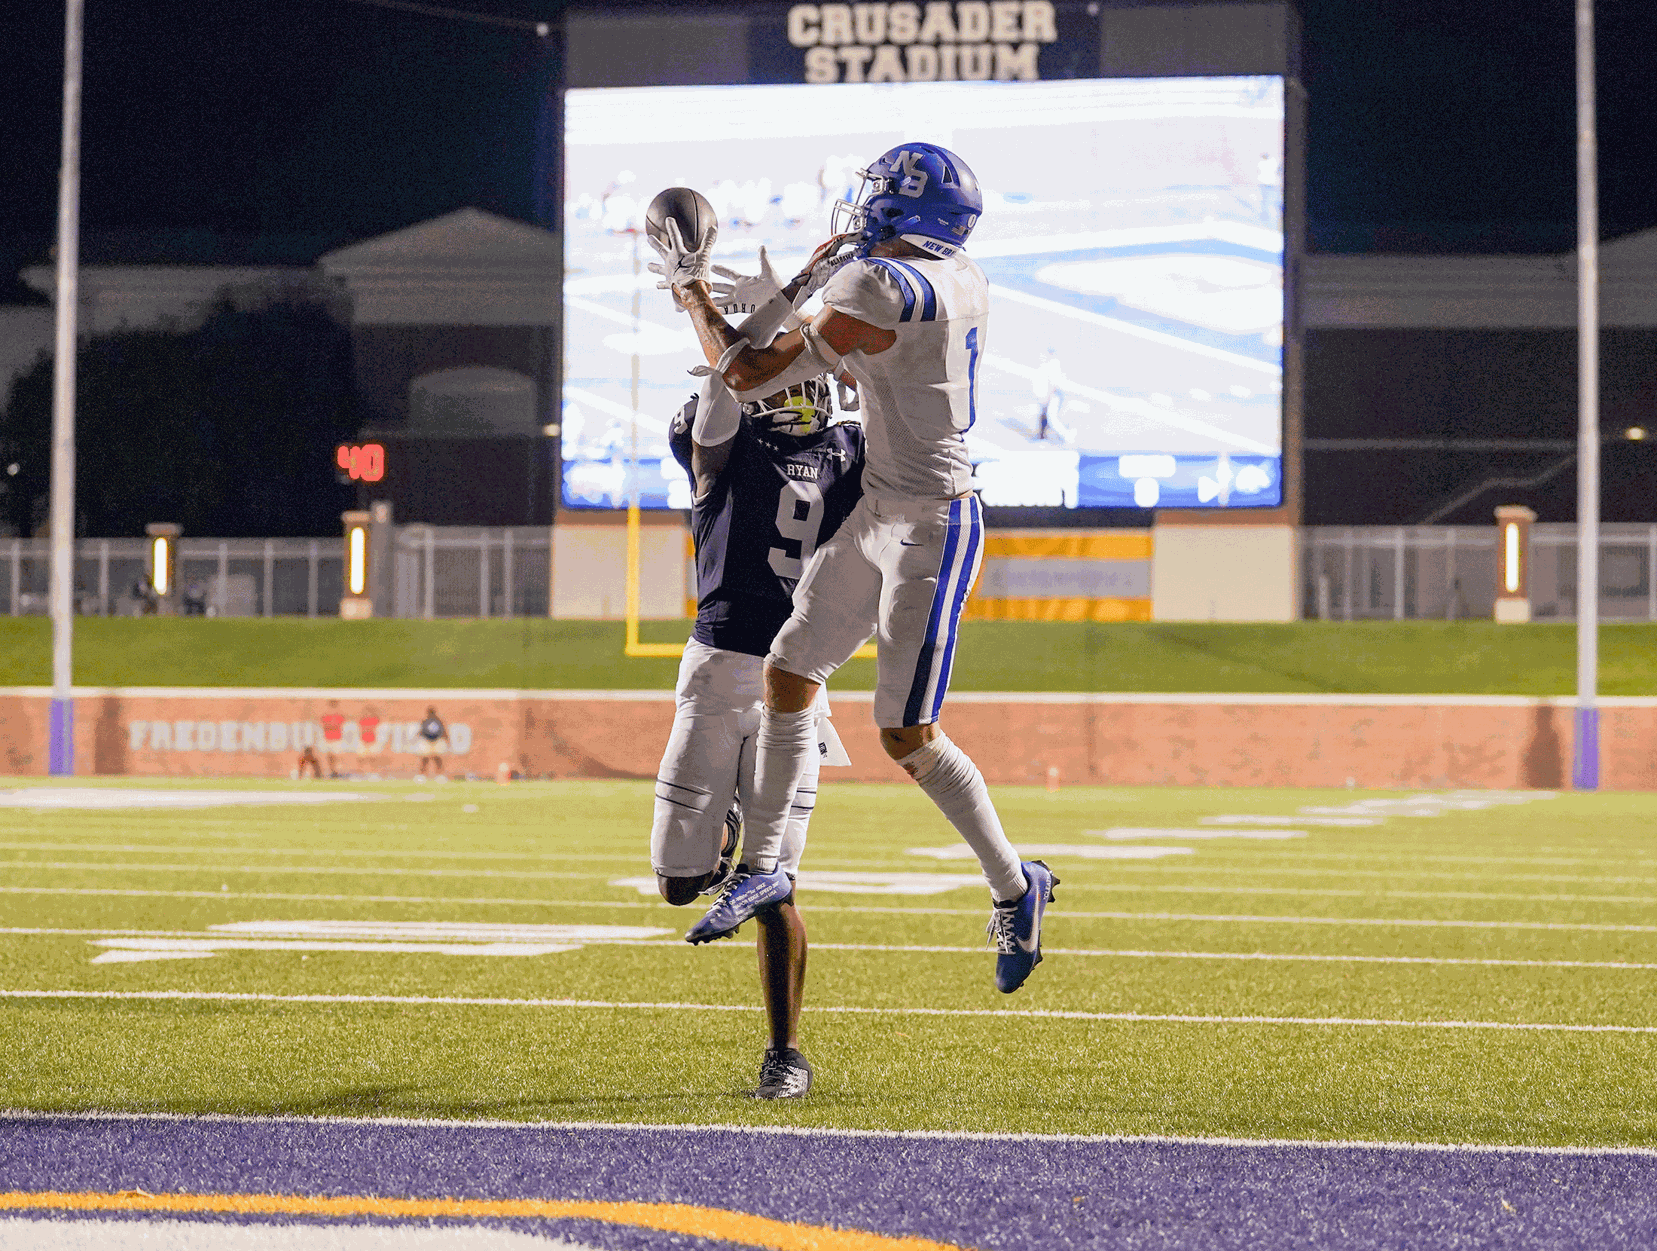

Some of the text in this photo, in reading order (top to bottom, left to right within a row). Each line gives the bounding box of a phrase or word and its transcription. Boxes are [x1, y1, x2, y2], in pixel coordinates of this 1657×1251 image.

[787, 1, 1057, 47] CRUSADER
[804, 43, 1039, 83] STADIUM
[922, 240, 944, 253] NEW
[960, 326, 979, 433] 1
[673, 404, 688, 435] 9
[336, 444, 385, 482] 40
[787, 464, 818, 481] RYAN
[767, 479, 825, 580] 9
